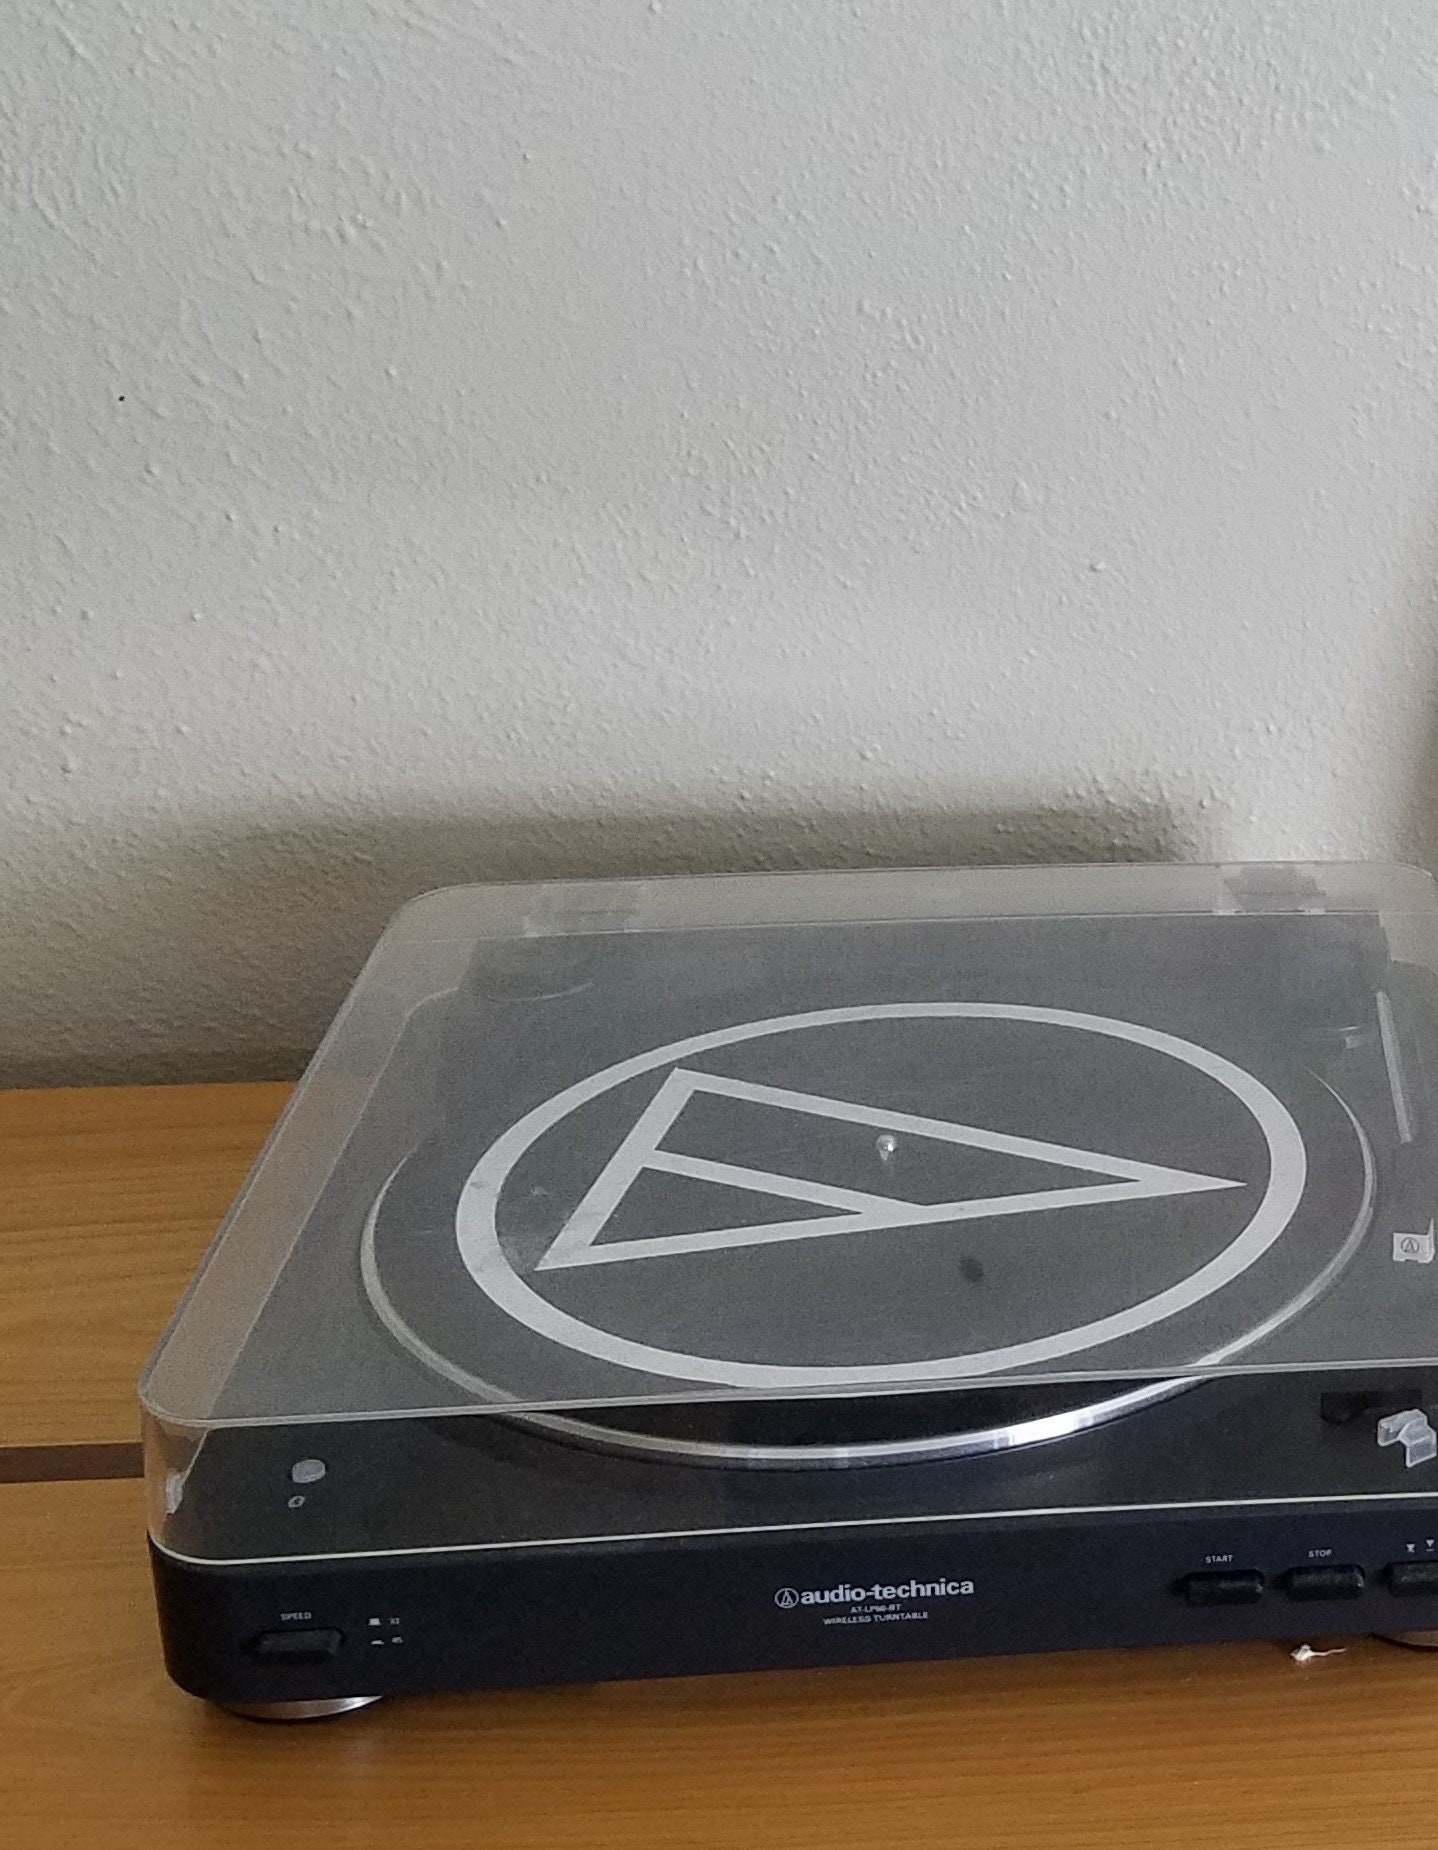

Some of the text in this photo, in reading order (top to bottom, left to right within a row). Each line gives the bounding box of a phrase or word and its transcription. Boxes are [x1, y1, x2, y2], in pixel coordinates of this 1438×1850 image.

[1308, 1549, 1332, 1558] STOP
[1205, 1554, 1233, 1564] START
[801, 1578, 974, 1604] audio-technica
[280, 1611, 312, 1621] SPEED
[823, 1611, 928, 1625] WIRELESS TURNTABLE
